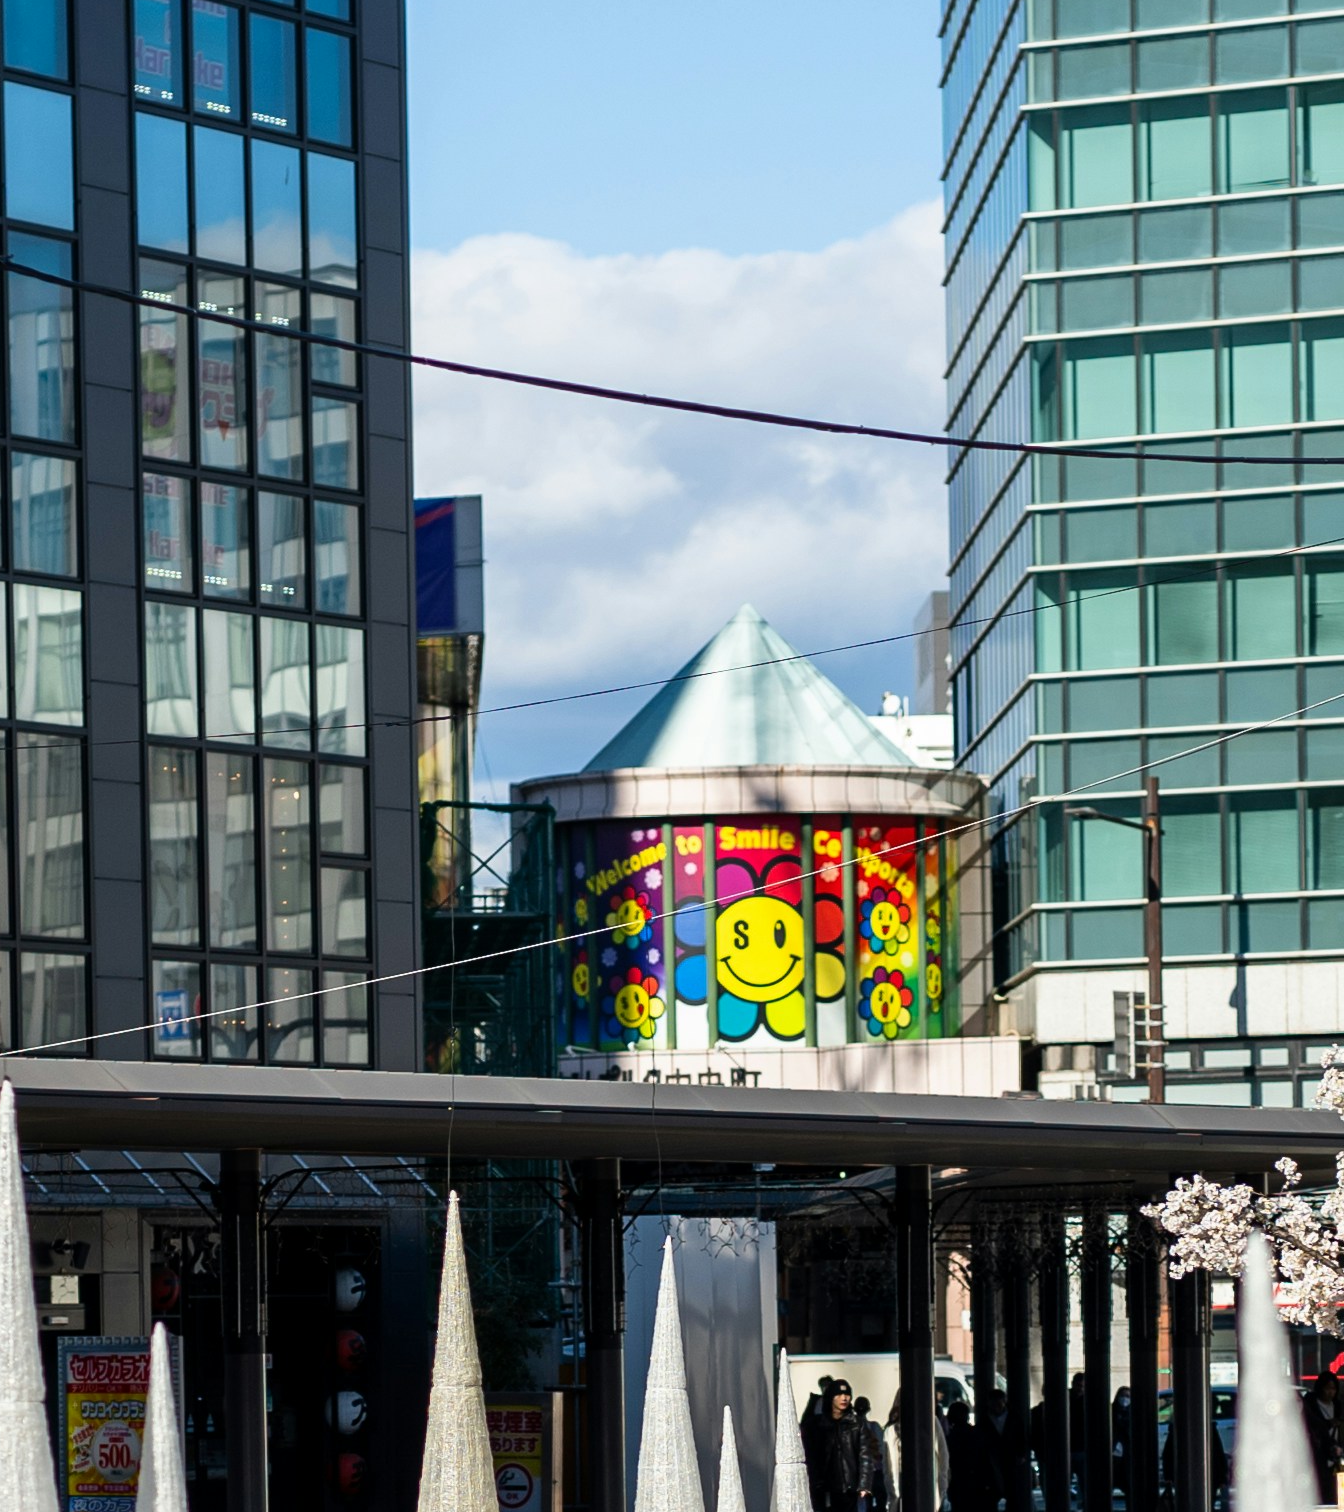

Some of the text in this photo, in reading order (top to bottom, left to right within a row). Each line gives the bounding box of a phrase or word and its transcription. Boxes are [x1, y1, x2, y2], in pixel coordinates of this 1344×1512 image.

[674, 834, 703, 856] to
[719, 825, 796, 851] Smile
[70, 1355, 150, 1382] セルフカラオ
[490, 1436, 538, 1453] あります
